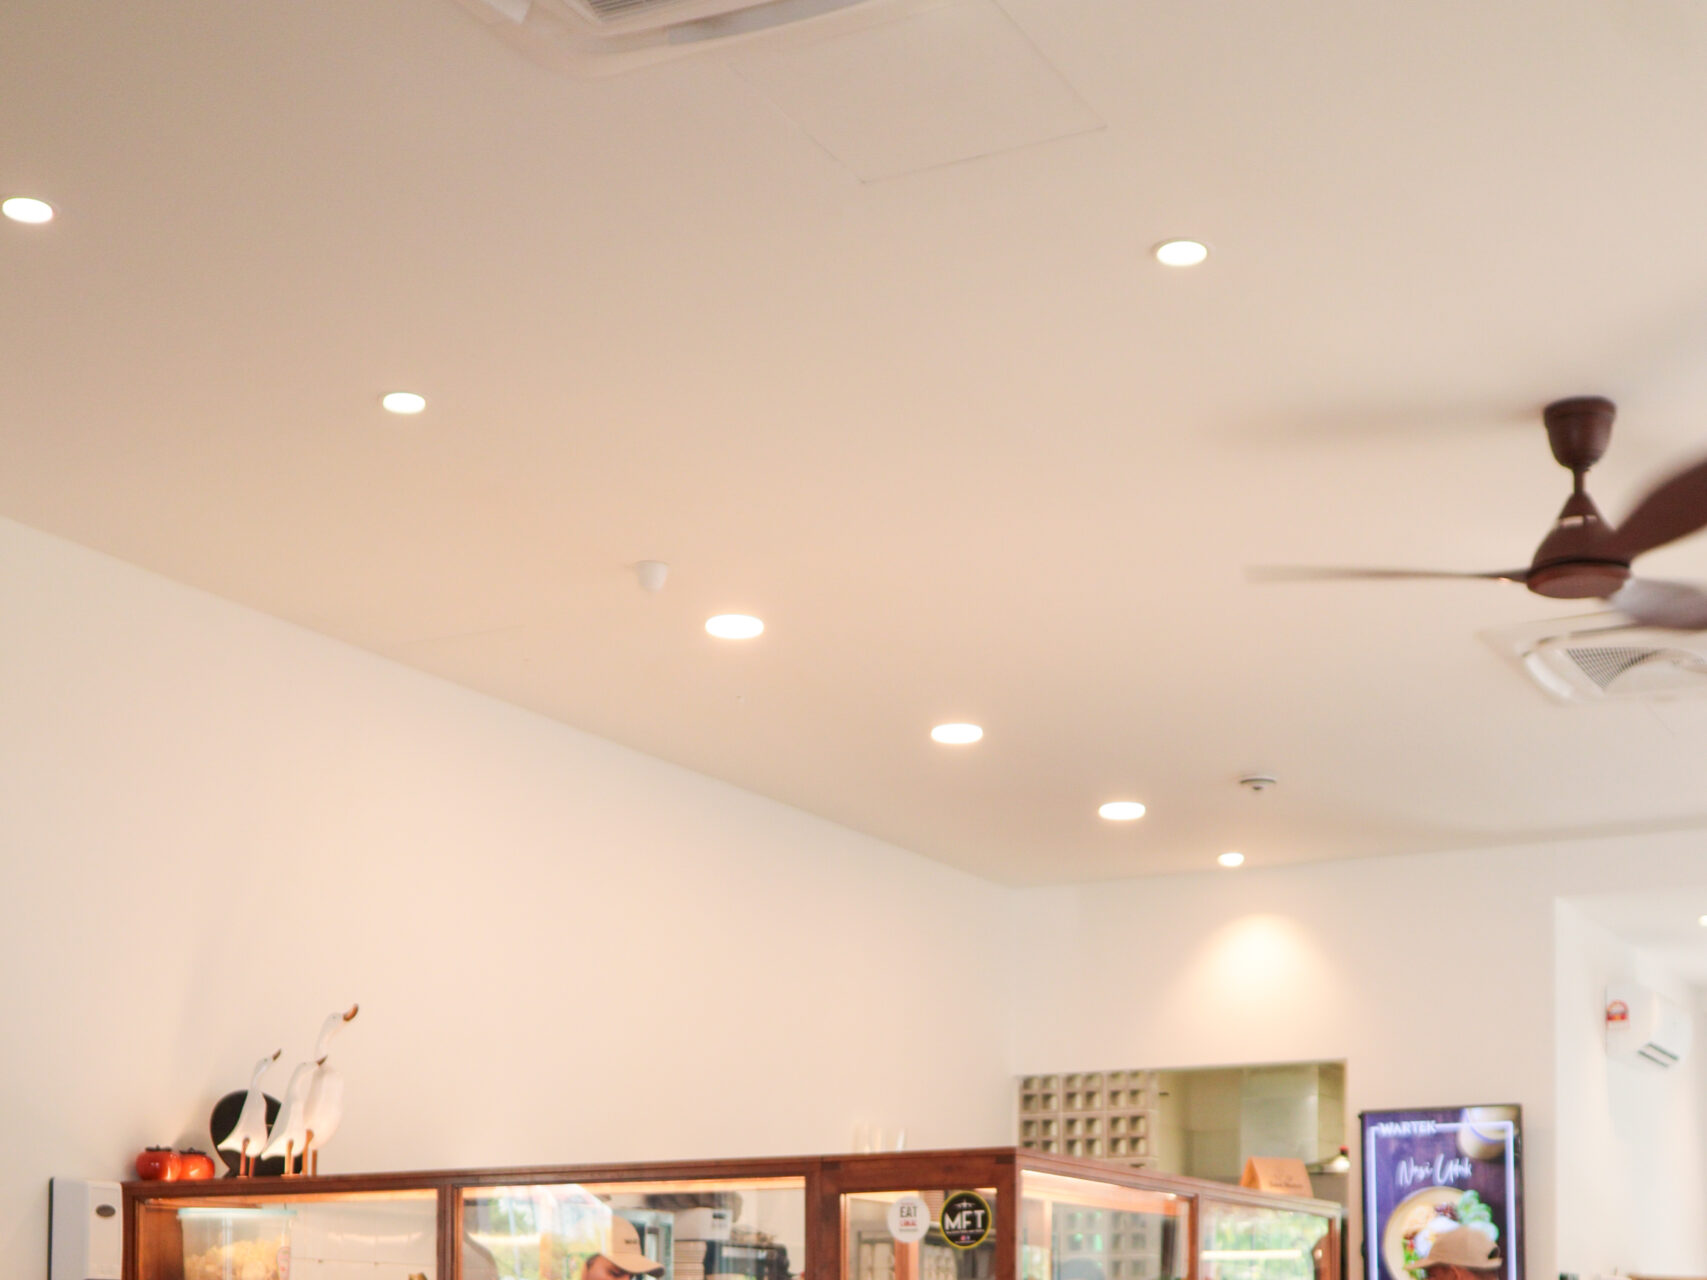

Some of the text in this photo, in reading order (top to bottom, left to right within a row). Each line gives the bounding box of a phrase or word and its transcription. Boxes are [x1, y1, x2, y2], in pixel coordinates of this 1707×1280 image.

[1376, 1120, 1436, 1136] WARTEK
[899, 1206, 918, 1218] EAT
[944, 1209, 985, 1230] MFT
